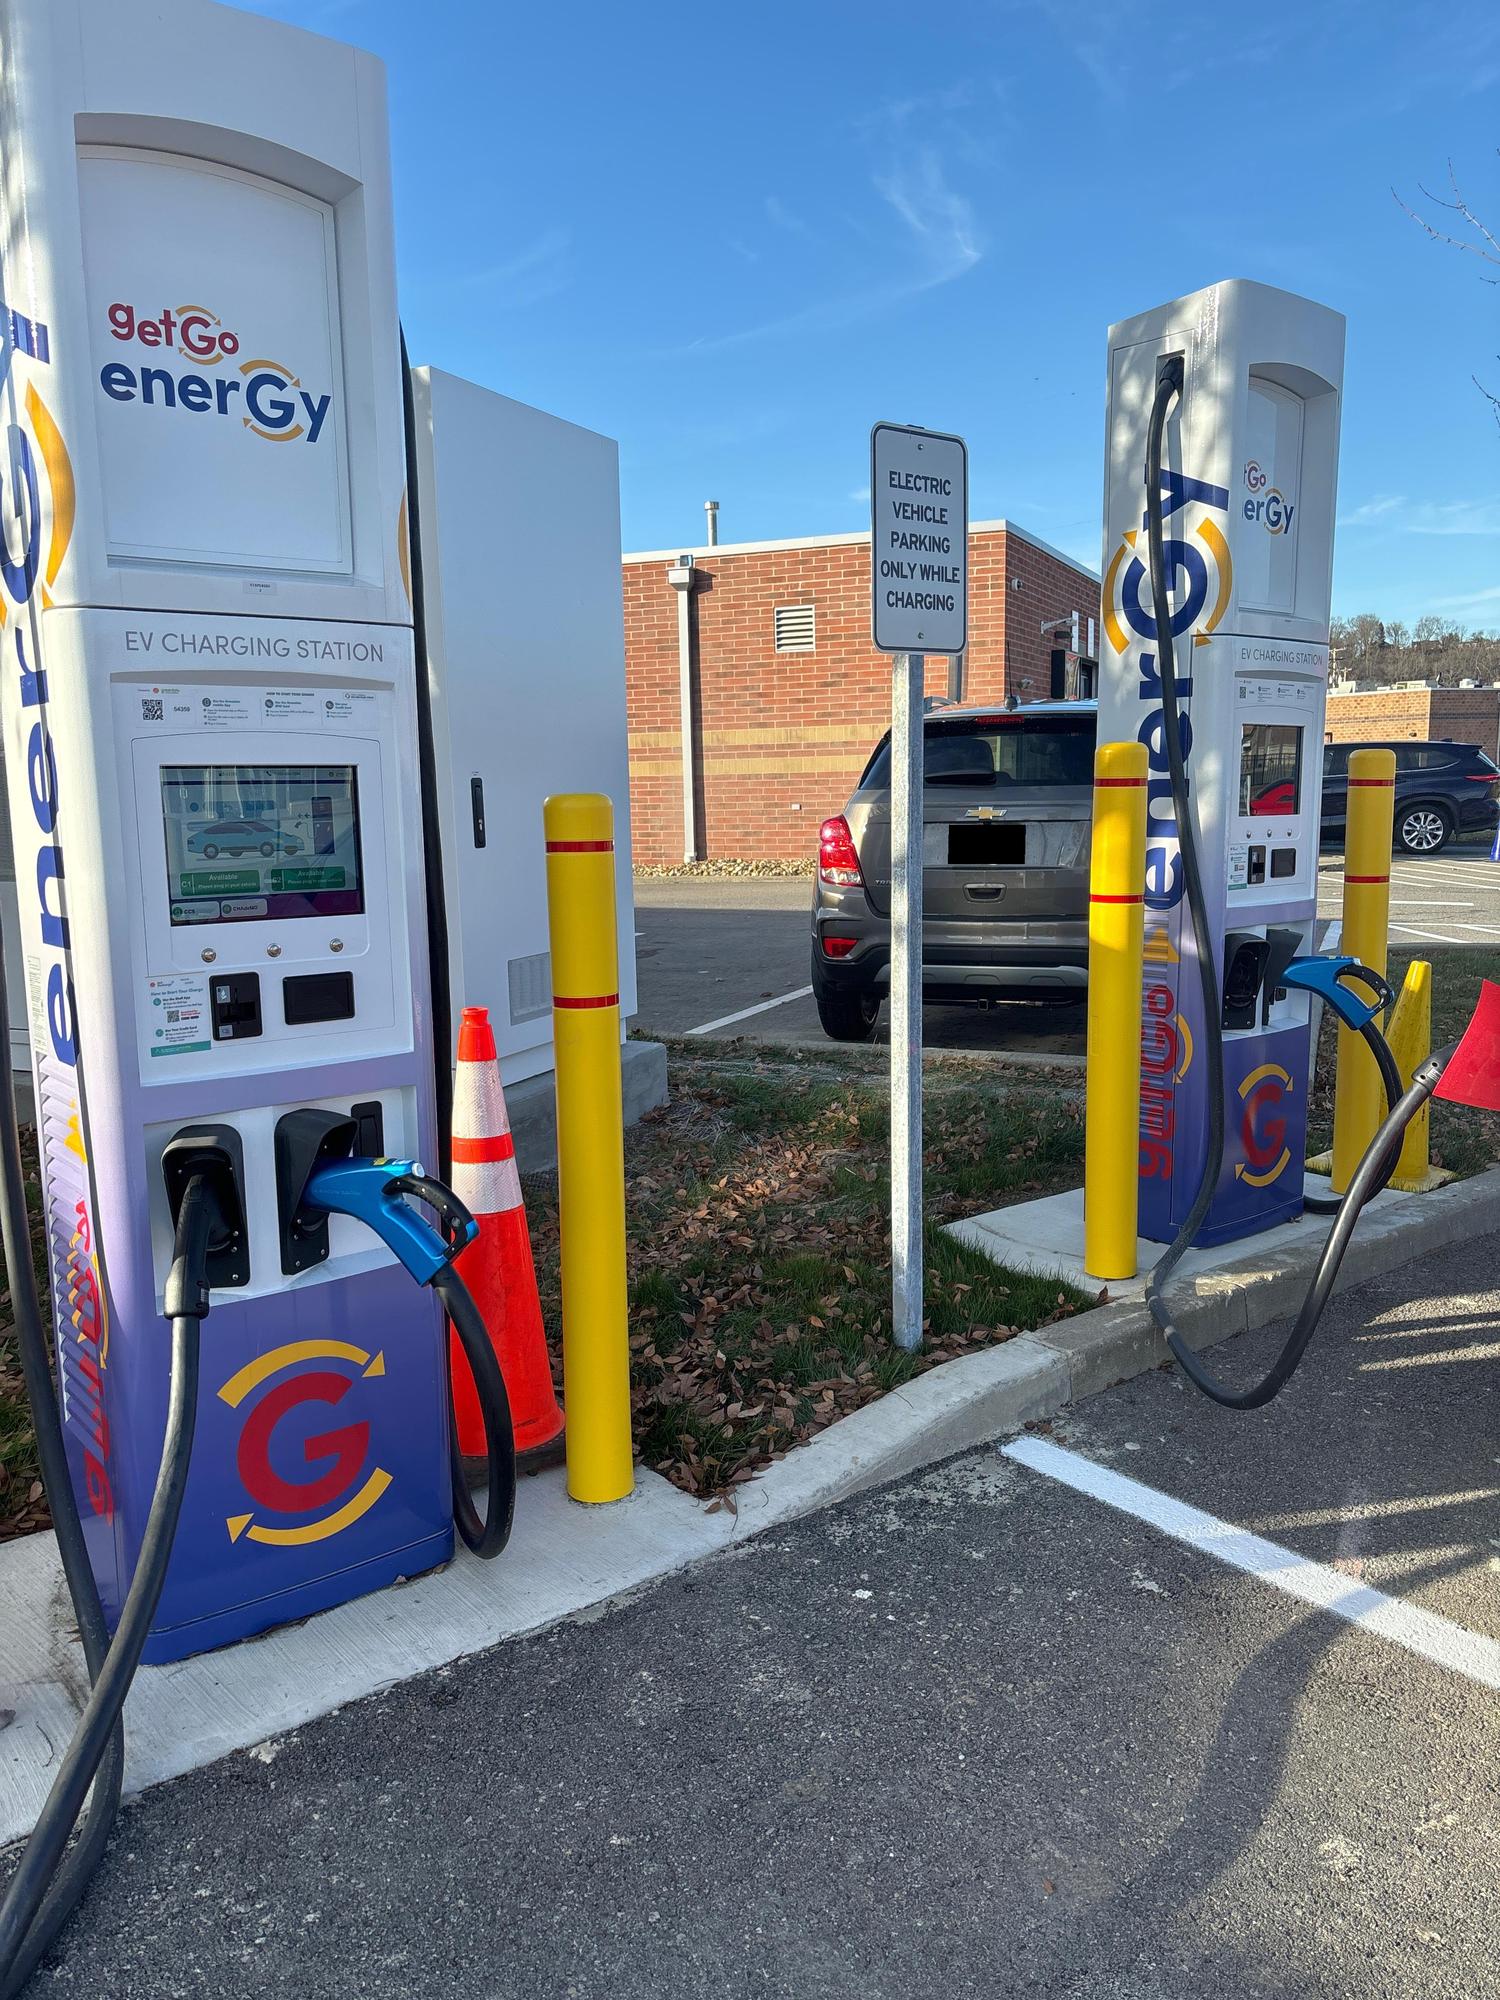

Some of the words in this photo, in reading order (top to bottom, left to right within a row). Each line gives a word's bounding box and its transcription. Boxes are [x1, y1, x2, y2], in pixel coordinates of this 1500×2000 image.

[108, 302, 239, 355] getGo
[100, 362, 331, 443] enerGy
[889, 470, 952, 496] ELECTRIC
[892, 501, 948, 525] VEHICLE
[1242, 495, 1294, 535] erGy
[890, 531, 950, 554] PARKING
[880, 560, 917, 580] ONLY
[920, 563, 960, 584] WHILE
[886, 590, 955, 612] CHARGING
[125, 631, 153, 652] EV
[161, 632, 291, 659] CHARGING
[297, 639, 384, 663] STATION
[1241, 647, 1251, 660] EV
[1253, 648, 1295, 663] CHARGING
[1295, 652, 1323, 666] STATION
[236, 1370, 371, 1514] G
